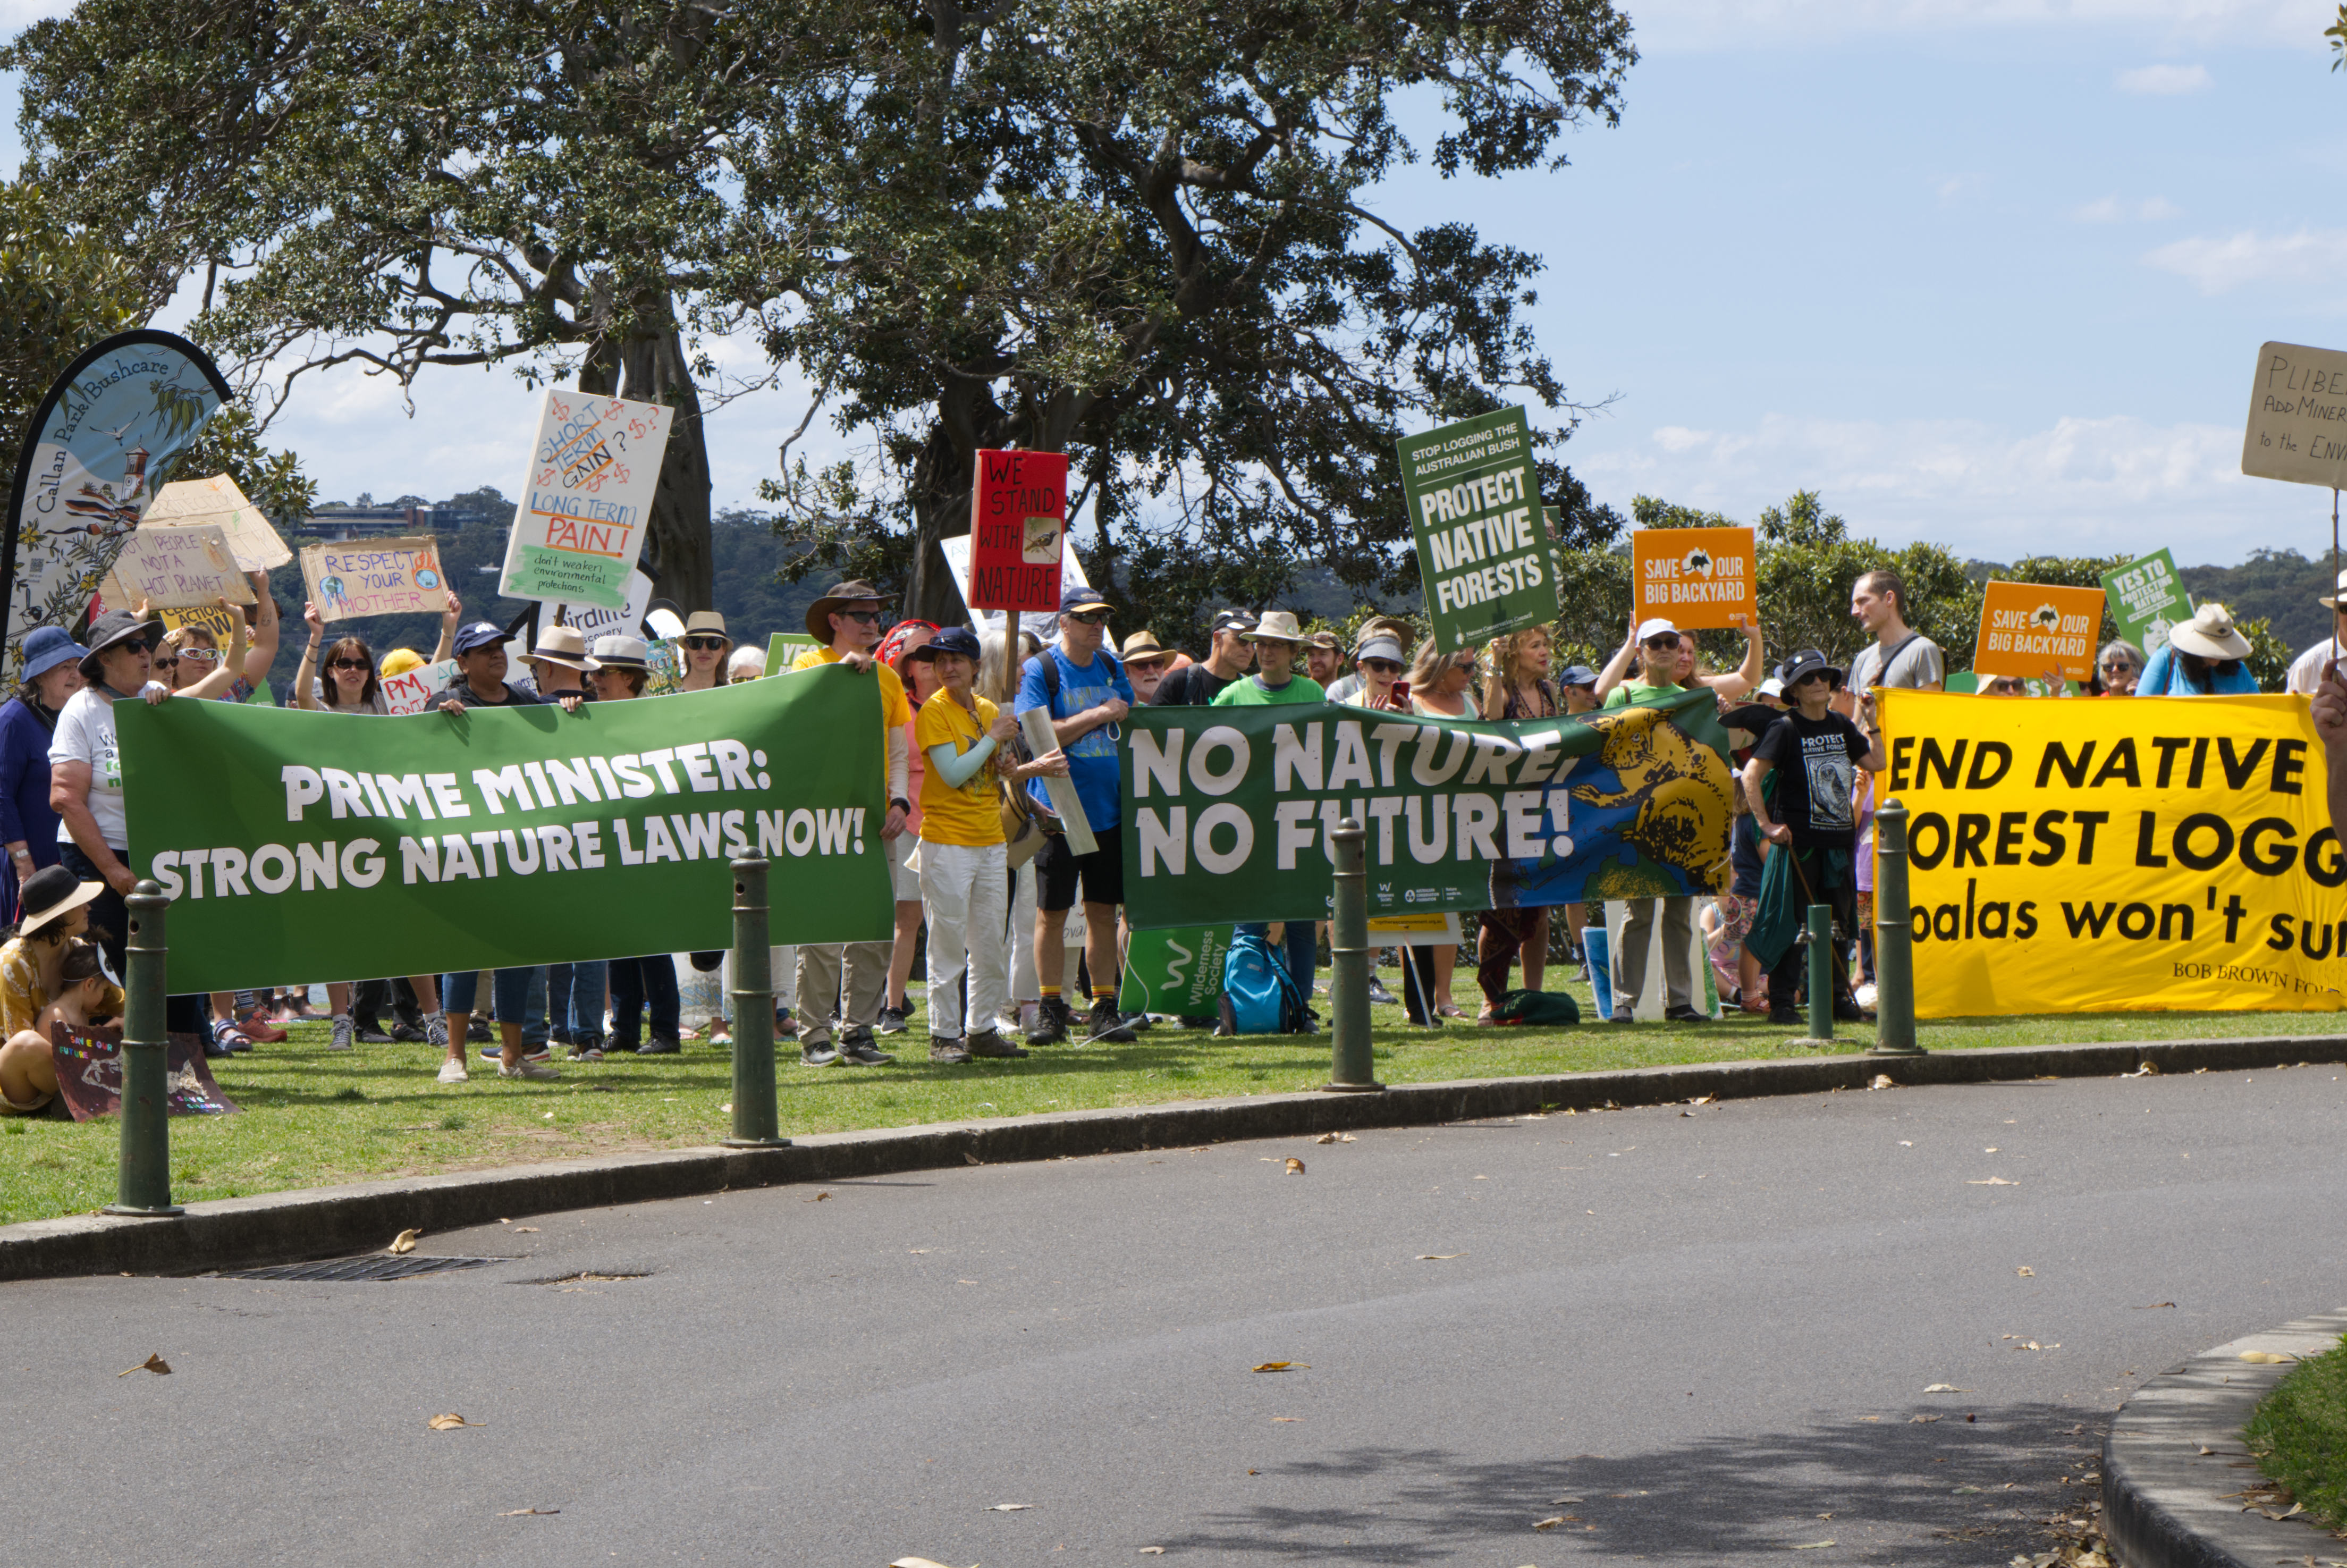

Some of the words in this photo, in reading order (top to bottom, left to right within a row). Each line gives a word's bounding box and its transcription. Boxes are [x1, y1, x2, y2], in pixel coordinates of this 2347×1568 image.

[2269, 355, 2347, 395] PLIBE
[37, 450, 66, 513] Callan
[54, 403, 89, 443] Park
[83, 359, 168, 400] Bushcare
[541, 401, 601, 463] SHORT
[552, 427, 606, 472] TERM
[1412, 444, 1441, 461] STOP
[1443, 430, 1493, 452] LOGGING
[1495, 423, 1518, 436] THE
[2260, 431, 2271, 446] to
[2280, 433, 2297, 451] the
[562, 445, 612, 488] GAIN
[989, 457, 1024, 485] WE
[1415, 448, 1485, 476] AUSTRALIAN
[1488, 437, 1521, 456] BUSH
[531, 492, 581, 516] LONG
[588, 500, 637, 527] TERM
[991, 488, 1056, 515] STAND
[1420, 466, 1525, 527] PROTECT
[155, 535, 200, 551] PEOPLE
[546, 517, 629, 558] PAIN!
[979, 523, 1019, 550] WITH
[1429, 507, 1535, 573] NATIVE
[141, 555, 167, 572] NOT
[174, 555, 184, 568] A
[325, 551, 413, 573] RESPECT
[534, 554, 558, 566] don't
[563, 561, 602, 572] weaken
[534, 566, 606, 584] environmental
[1645, 558, 1679, 579] SAVE
[1716, 557, 1744, 577] OUR
[2112, 568, 2145, 595] YES
[2142, 559, 2166, 581] TO
[140, 576, 169, 597] HOT
[174, 575, 225, 593] PLANET
[360, 573, 404, 589] YOUR
[538, 580, 585, 593] protections
[976, 567, 1055, 605] NATURE
[1436, 553, 1543, 614] FORESTS
[1645, 584, 1668, 605] BIG
[1672, 581, 1745, 603] BACKYARD
[2120, 574, 2173, 606] PROTECTING
[337, 592, 427, 616] MOTHER
[2133, 588, 2168, 611] NATURE
[1992, 609, 2028, 630] SAVE
[2062, 614, 2089, 634] OUR
[1988, 633, 2014, 652] BIG
[2015, 634, 2086, 657] BACKYARD
[1129, 726, 1251, 797] NO
[1272, 720, 1581, 791] NATURE,
[1889, 737, 2013, 792] END
[2035, 737, 2308, 795] NATIVE
[281, 764, 471, 822] PRIME
[472, 738, 772, 814] MINISTER:
[1135, 803, 1254, 877] NO
[1273, 789, 1574, 870] FUTURE!
[1908, 809, 2109, 871] OREST
[151, 838, 386, 901] STRONG
[399, 821, 605, 885] NATURE
[613, 809, 746, 866] LAWS
[756, 807, 866, 858] NOW!
[1910, 878, 2038, 943] oalas
[2061, 886, 2247, 943] won't
[1188, 931, 1214, 1006] Wilderness
[1204, 943, 1227, 995] Society
[2173, 962, 2211, 979] BOB
[2217, 965, 2289, 989] BROWN
[59, 1046, 89, 1059] FUTURE
[70, 1035, 92, 1048] SAVE
[96, 1041, 113, 1052] OUR
